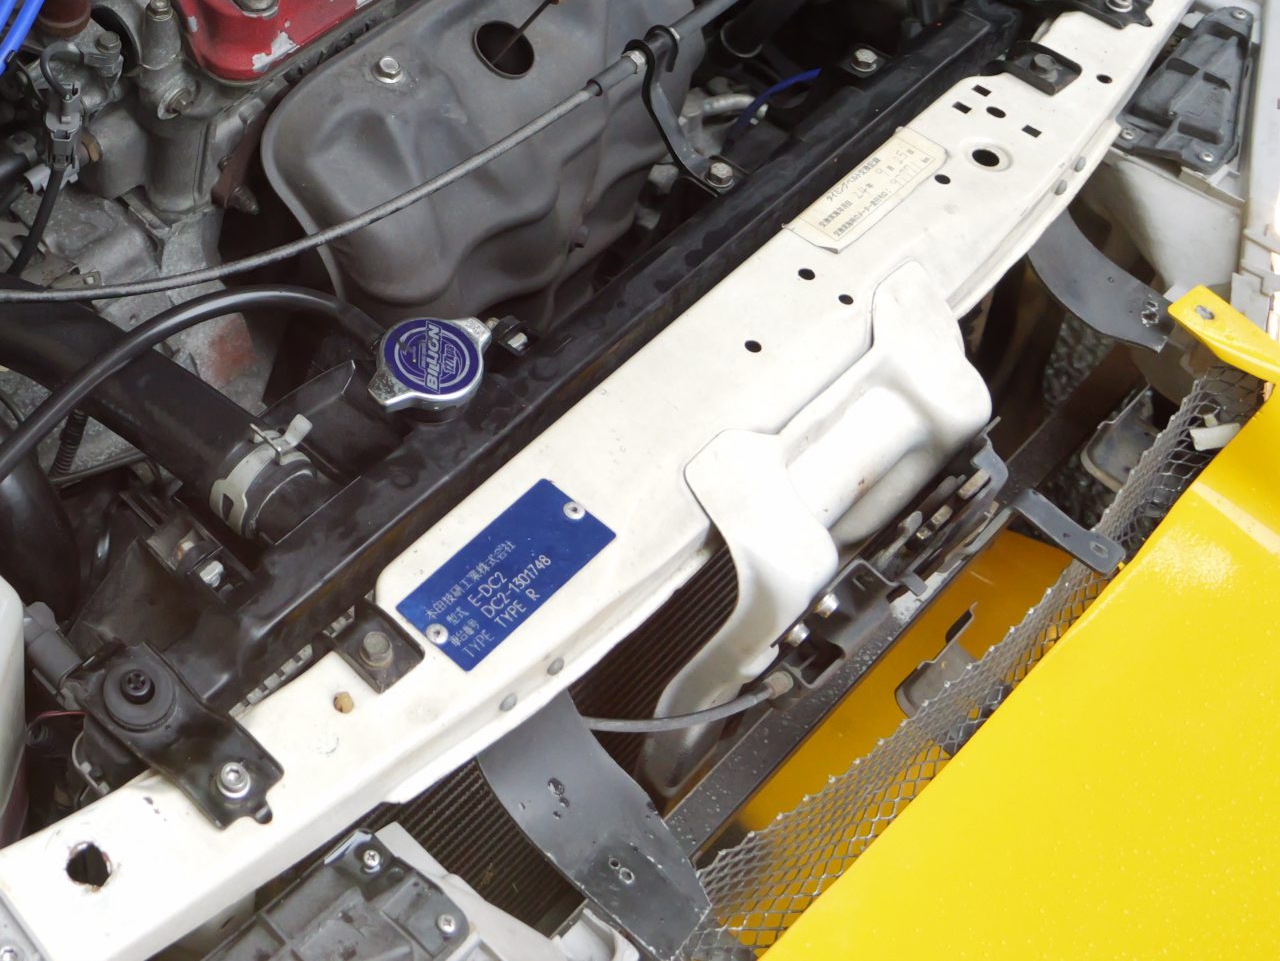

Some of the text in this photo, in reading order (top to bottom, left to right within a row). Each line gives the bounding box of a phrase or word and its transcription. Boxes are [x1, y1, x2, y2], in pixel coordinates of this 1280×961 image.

[426, 323, 441, 391] BILLION
[467, 571, 508, 607] E-DC2
[480, 554, 552, 619] DC2-1301748
[462, 587, 540, 659] TYPE TYPE R
